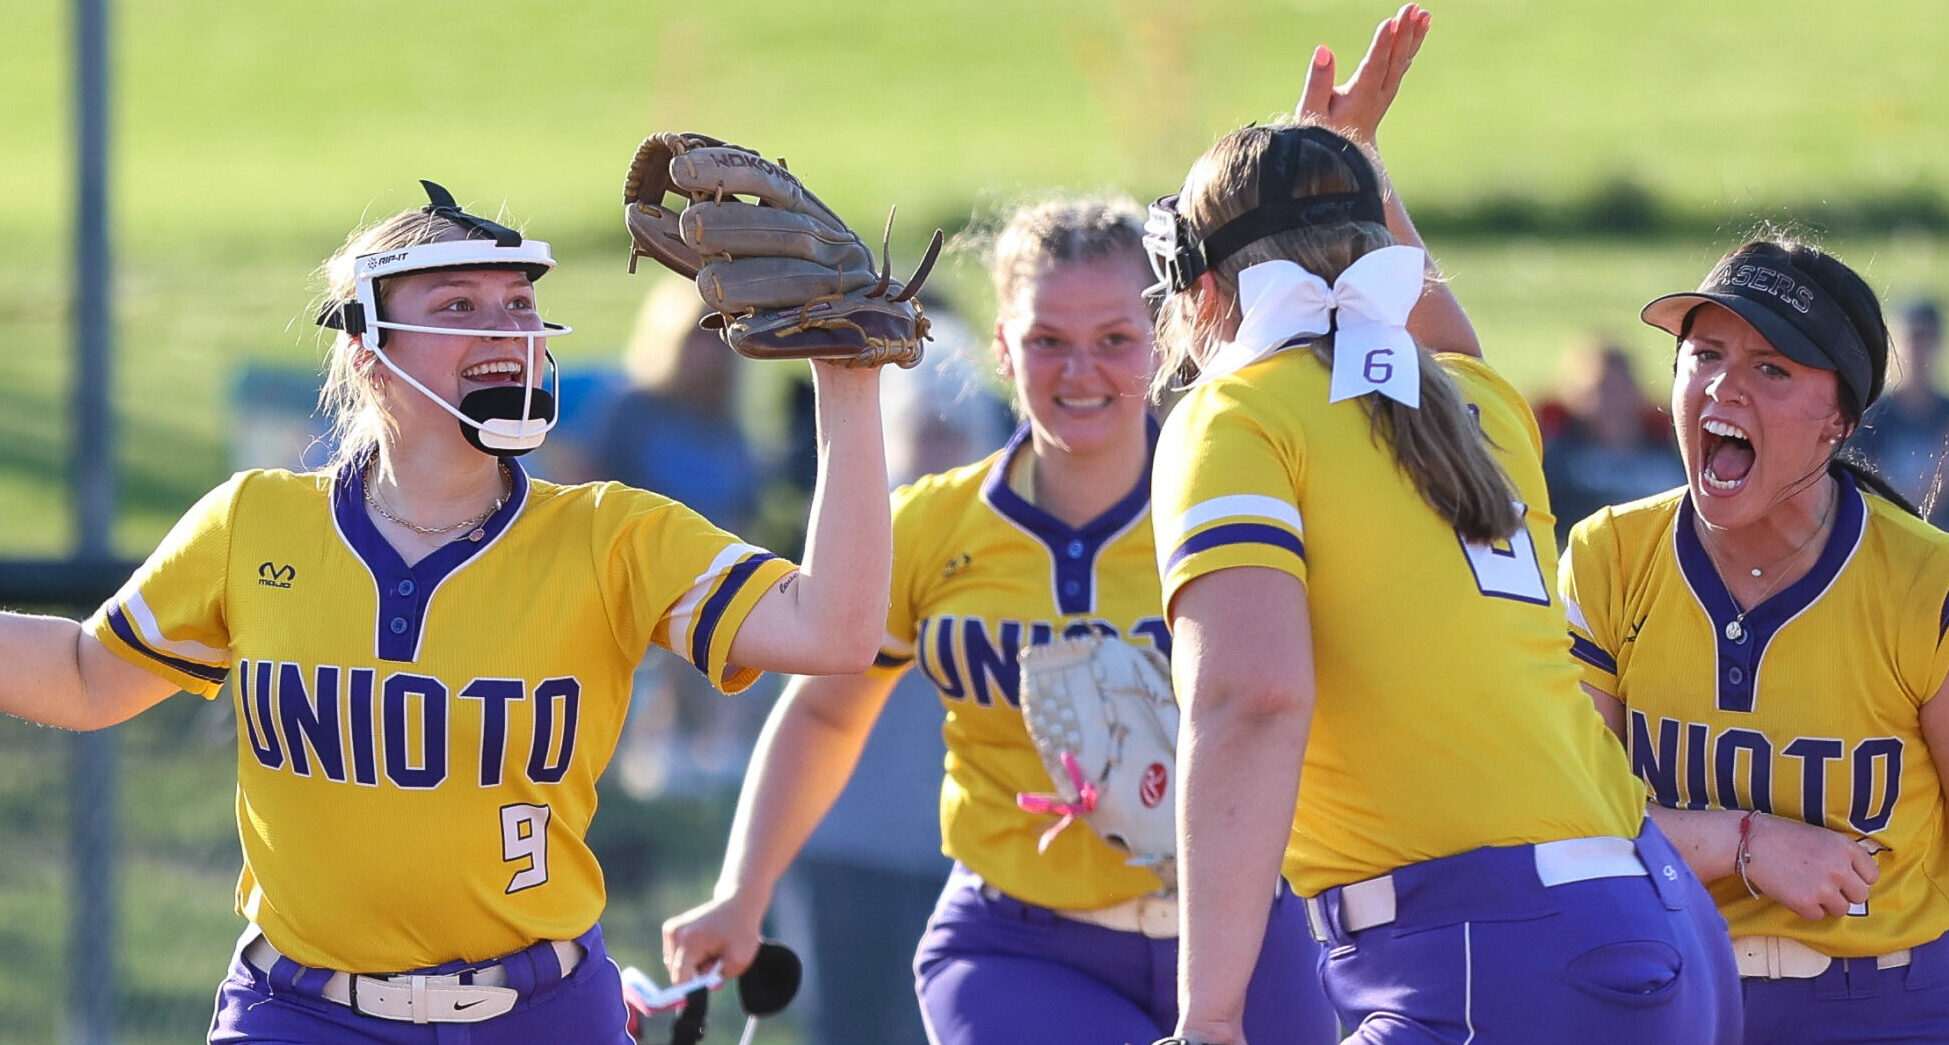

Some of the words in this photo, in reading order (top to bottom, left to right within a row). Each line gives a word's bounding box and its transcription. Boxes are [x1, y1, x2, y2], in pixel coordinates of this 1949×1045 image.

[378, 251, 409, 266] RIP-IT
[1709, 263, 1815, 314] ASERS
[1363, 347, 1396, 385] 6
[239, 658, 581, 790] UNIOTO
[1628, 709, 1905, 835] NIOTO
[499, 802, 551, 895] 9
